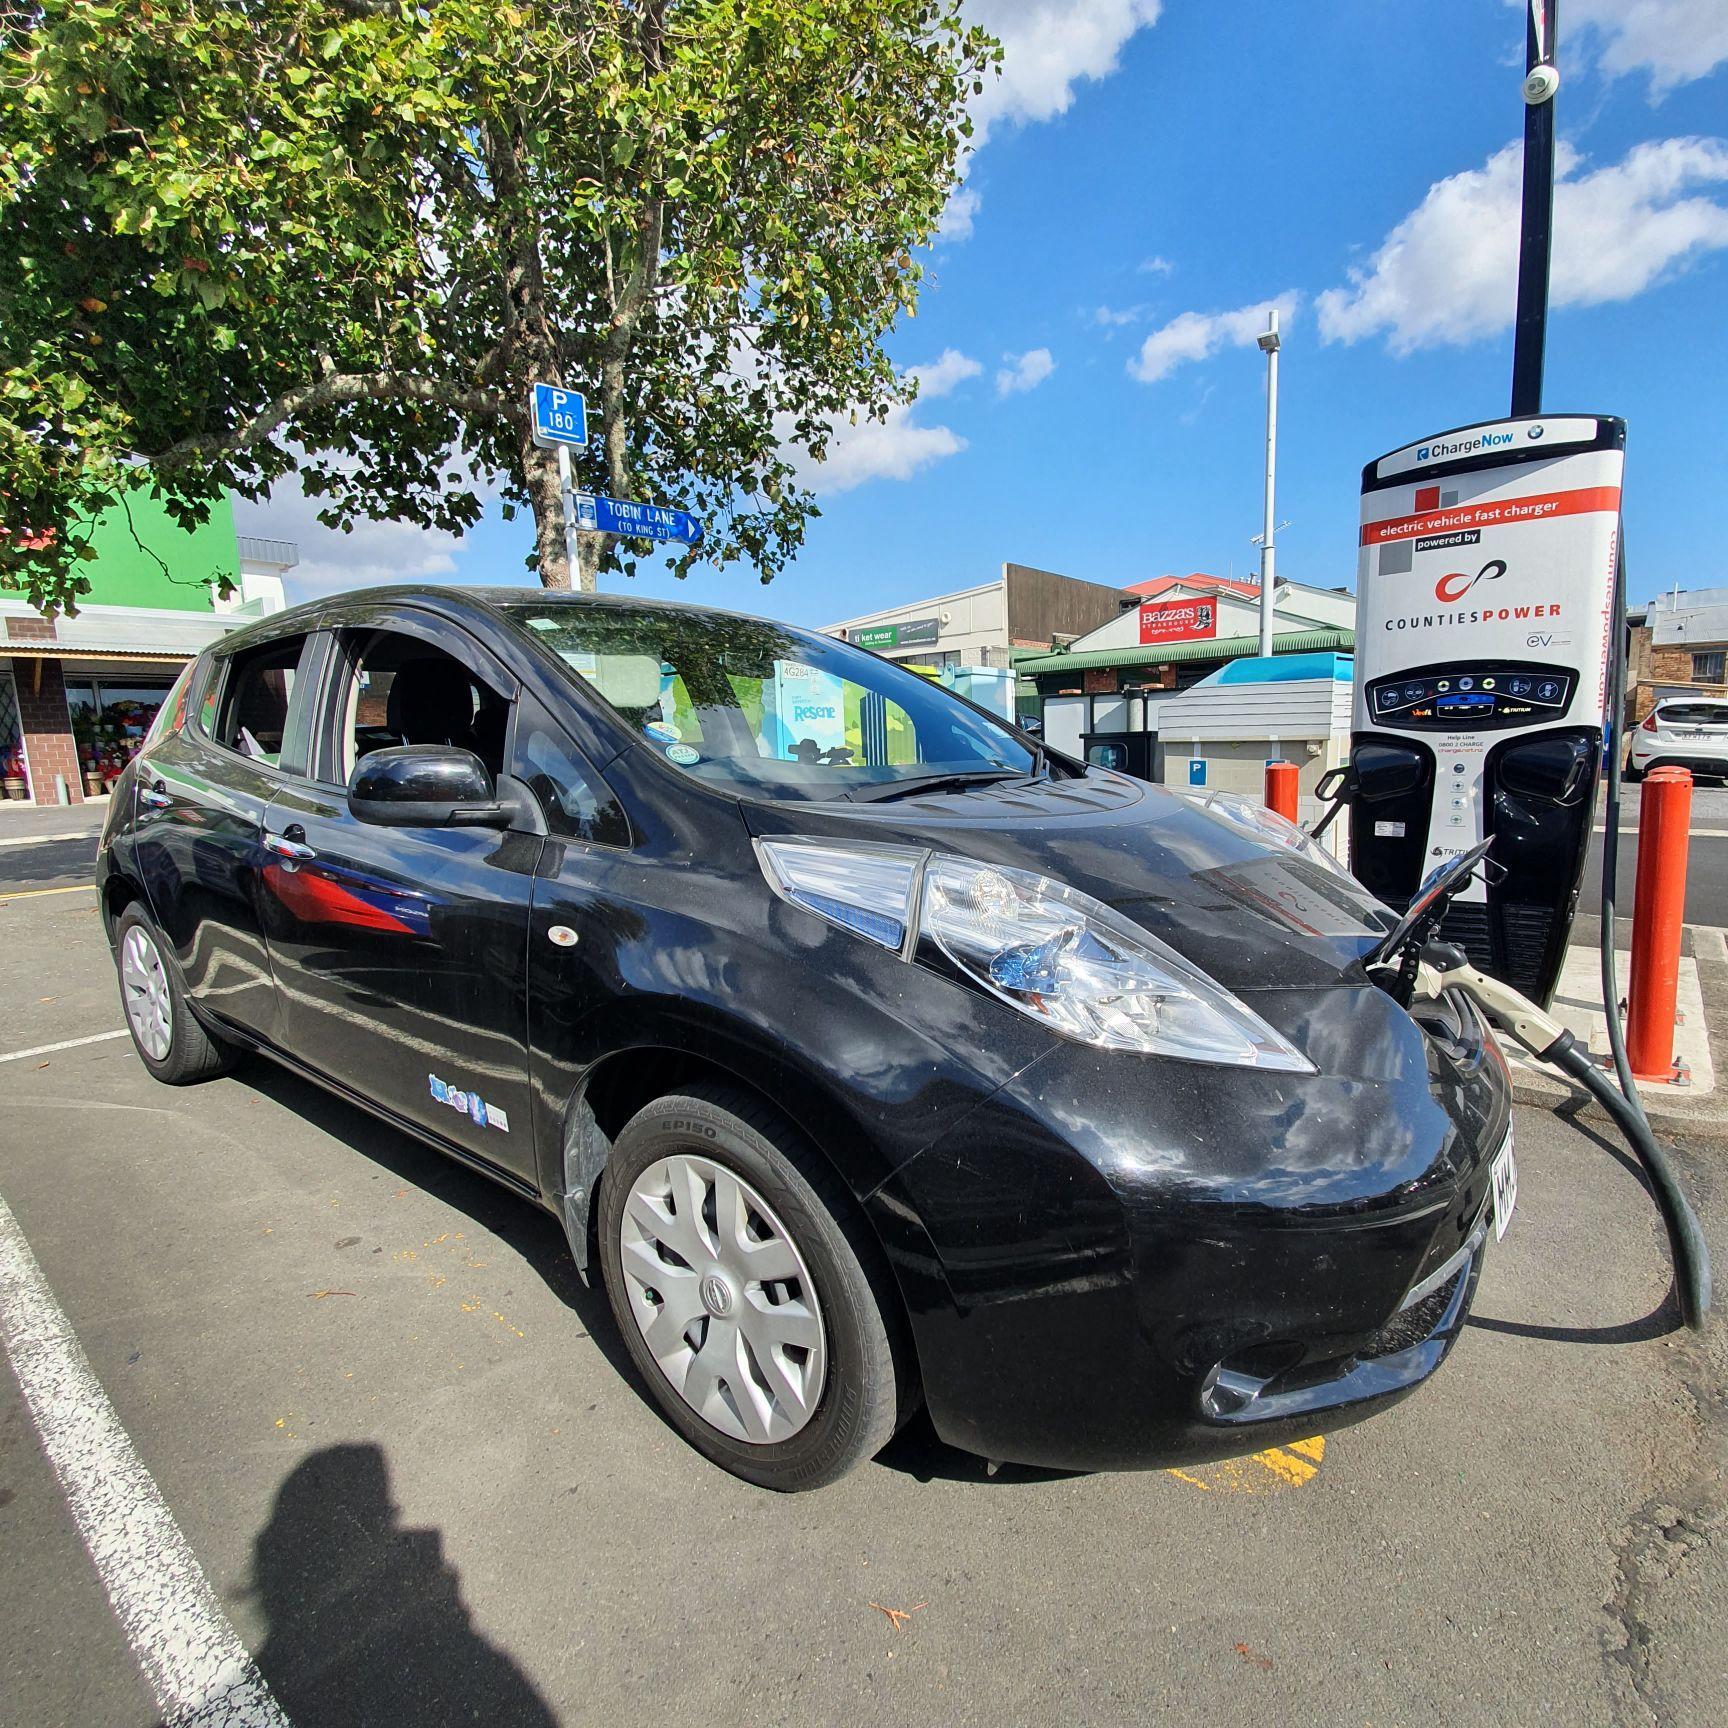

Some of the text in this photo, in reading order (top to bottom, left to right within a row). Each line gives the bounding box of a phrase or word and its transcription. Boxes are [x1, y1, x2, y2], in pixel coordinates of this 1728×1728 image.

[553, 390, 568, 410] P
[549, 411, 574, 431] 180
[1431, 432, 1513, 458] ChargeNow
[607, 501, 642, 520] TOBIN
[646, 508, 676, 526] LANE
[1380, 501, 1560, 537] electric vehicle fast charger
[618, 520, 670, 539] (TO KING ST)
[1417, 532, 1478, 551] powered by
[1142, 619, 1194, 629] STEAKHOUSE
[873, 631, 892, 640] wear
[793, 705, 836, 721] Resene
[1192, 763, 1202, 773] P
[662, 1120, 717, 1139] EP150
